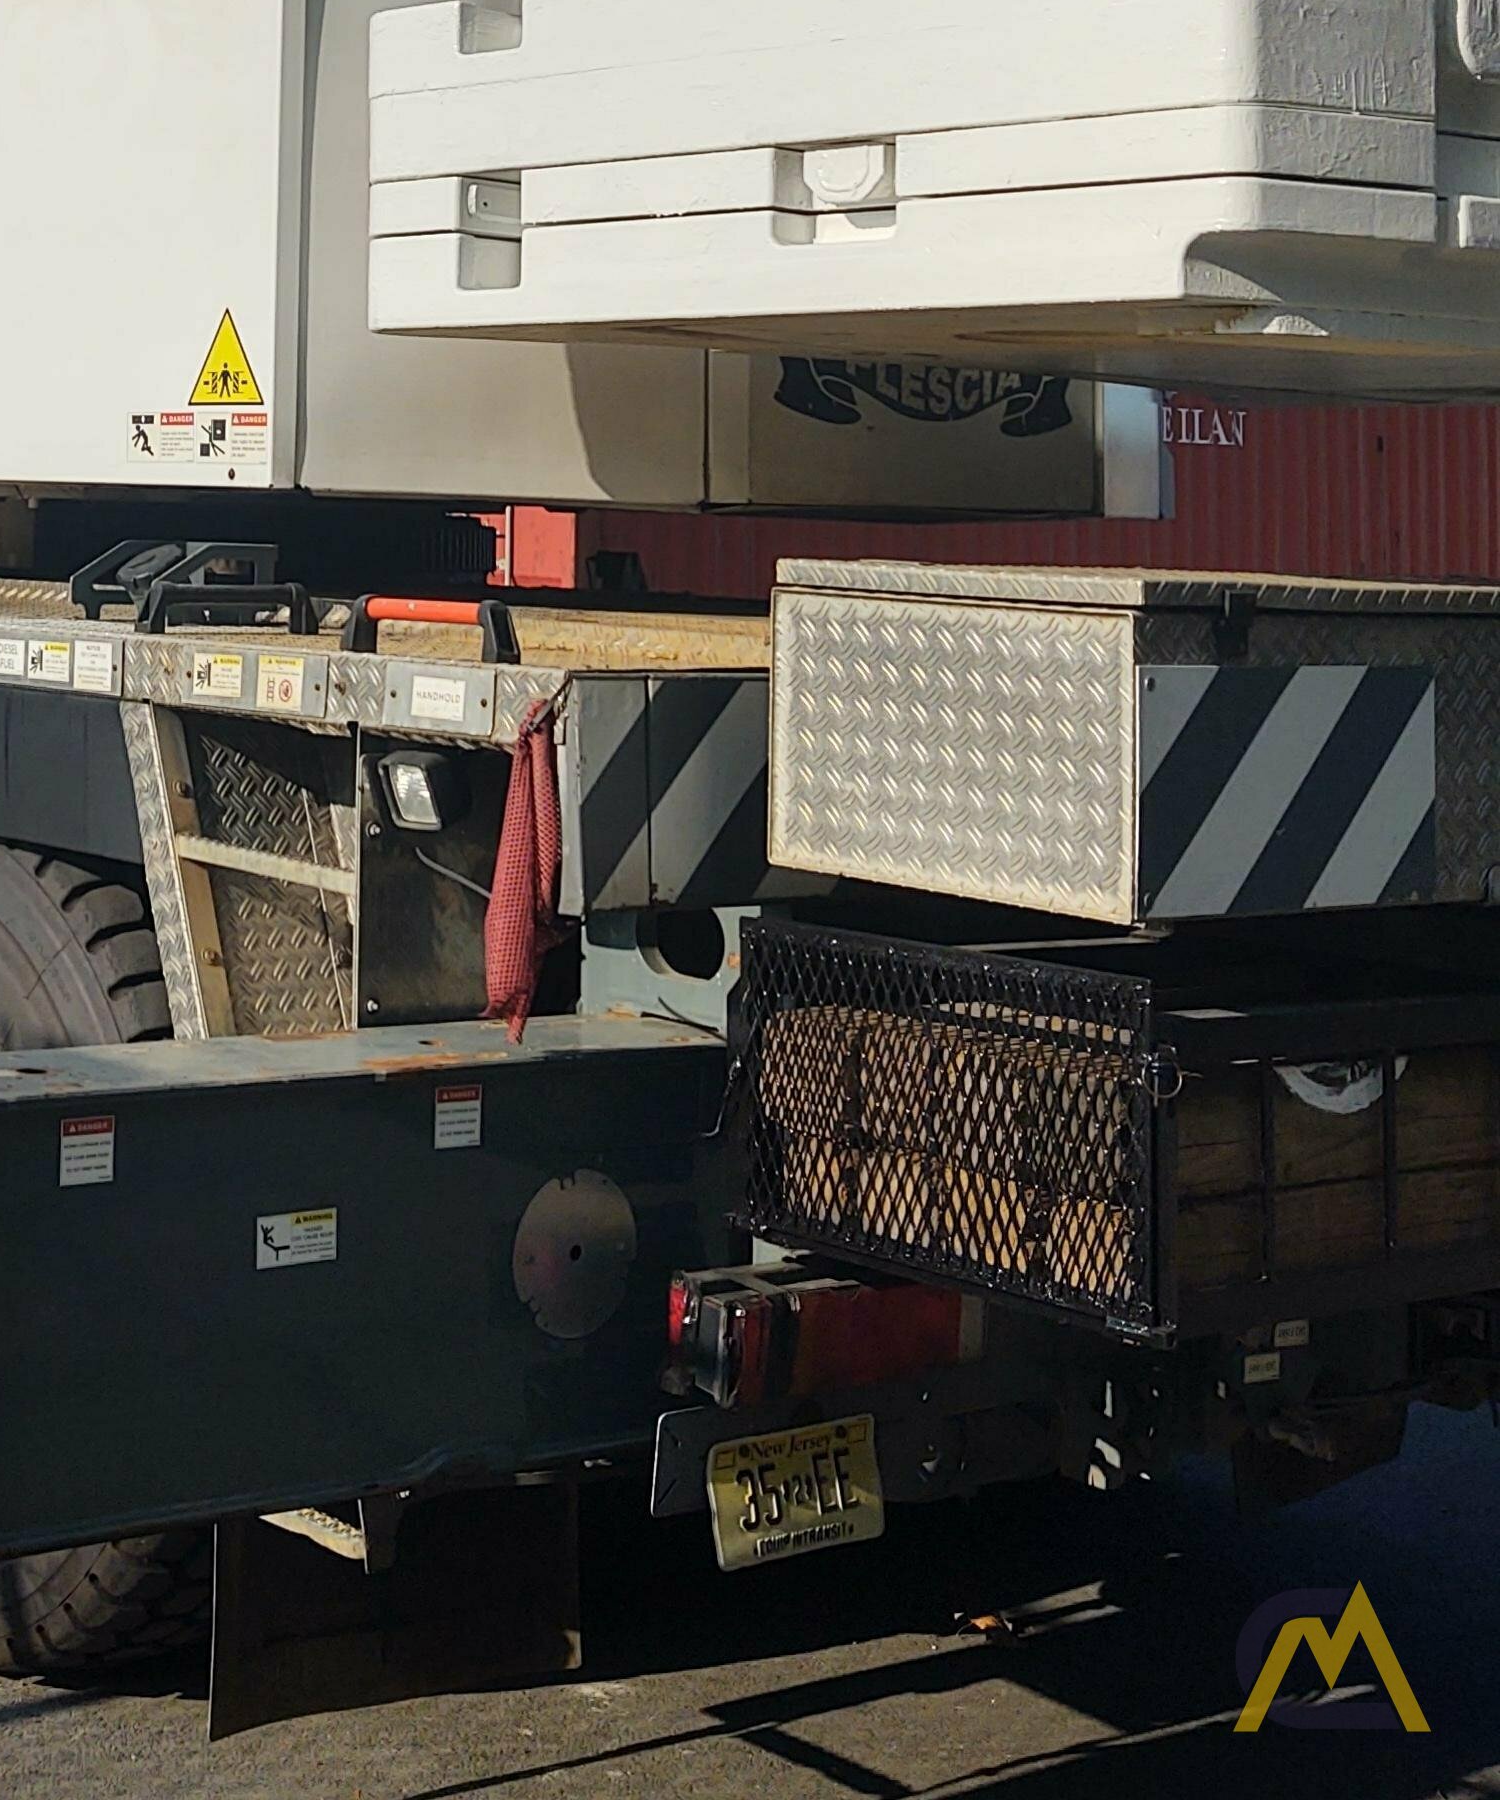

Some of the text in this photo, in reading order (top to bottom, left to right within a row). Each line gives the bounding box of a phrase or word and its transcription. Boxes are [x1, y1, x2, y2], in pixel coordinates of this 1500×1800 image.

[168, 415, 194, 423] DANGER
[240, 415, 267, 423] DANGER
[416, 690, 461, 704] HANDHOLD
[750, 1433, 832, 1461] New Jersey
